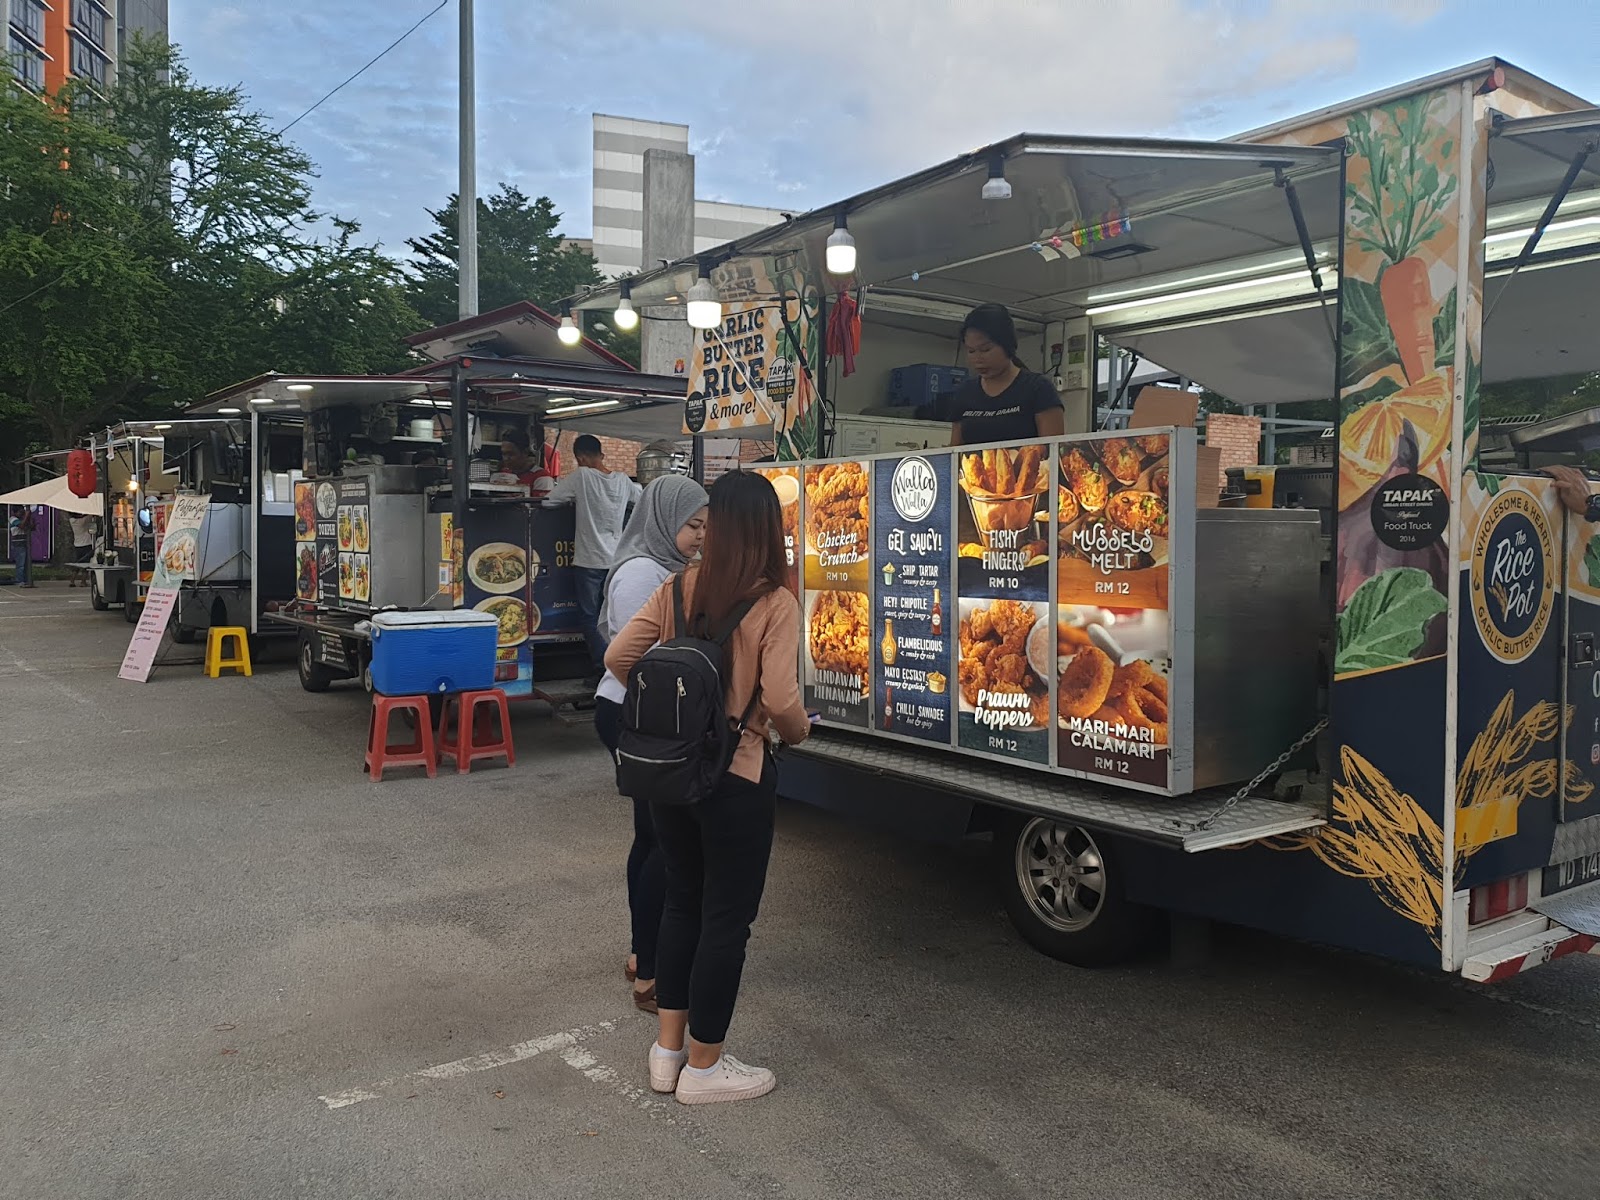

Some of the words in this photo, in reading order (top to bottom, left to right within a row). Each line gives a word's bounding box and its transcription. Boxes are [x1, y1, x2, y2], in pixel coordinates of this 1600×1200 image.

[703, 334, 764, 366] BUTTER
[703, 357, 765, 400] RICE
[1383, 489, 1434, 502] TAPAK
[1384, 522, 1407, 530] Food
[1408, 521, 1432, 530] Truck
[1476, 497, 1522, 557] WHOLESOME
[1530, 506, 1552, 558] HEARTY
[817, 530, 857, 549] Chicken
[888, 528, 907, 555] GET
[910, 527, 942, 556] SAUCY!
[989, 529, 1018, 549] FISHY
[1072, 523, 1153, 553] MUSSELS
[1515, 529, 1527, 546] The
[819, 548, 858, 567] Crunch
[982, 551, 1026, 572] FINGERS
[1091, 552, 1134, 575] MELT
[1491, 538, 1535, 586] Rice
[826, 572, 838, 581] RM
[839, 572, 848, 582] 10
[902, 564, 916, 576] SHIP
[919, 564, 939, 577] TARTAR
[989, 577, 1005, 588] RM
[1007, 578, 1019, 589] 10
[1095, 581, 1114, 594] RM
[1117, 582, 1130, 594] 12
[883, 596, 898, 608] HEY!
[900, 597, 928, 610] CHIPOTLE
[1503, 579, 1535, 623] Pot
[1478, 606, 1503, 650] GARLIC
[1503, 632, 1535, 655] BUTTER
[1534, 601, 1549, 634] RICE
[898, 636, 943, 652] FLAMBELICIOUS
[884, 666, 900, 679] MAYO
[902, 668, 926, 682] ECSTASY
[978, 688, 1031, 708] Prawn
[828, 706, 840, 716] RM
[841, 708, 847, 717] 8
[896, 702, 915, 716] CHILLI
[918, 705, 944, 721] SAWADEE
[974, 706, 1034, 731] Poppers
[1070, 716, 1155, 743] MARI-MARI
[989, 736, 1004, 749] RM
[1005, 739, 1017, 752] 12
[1070, 733, 1155, 760] CALAMARI
[1095, 757, 1114, 771] RM
[1117, 761, 1129, 773] 12
